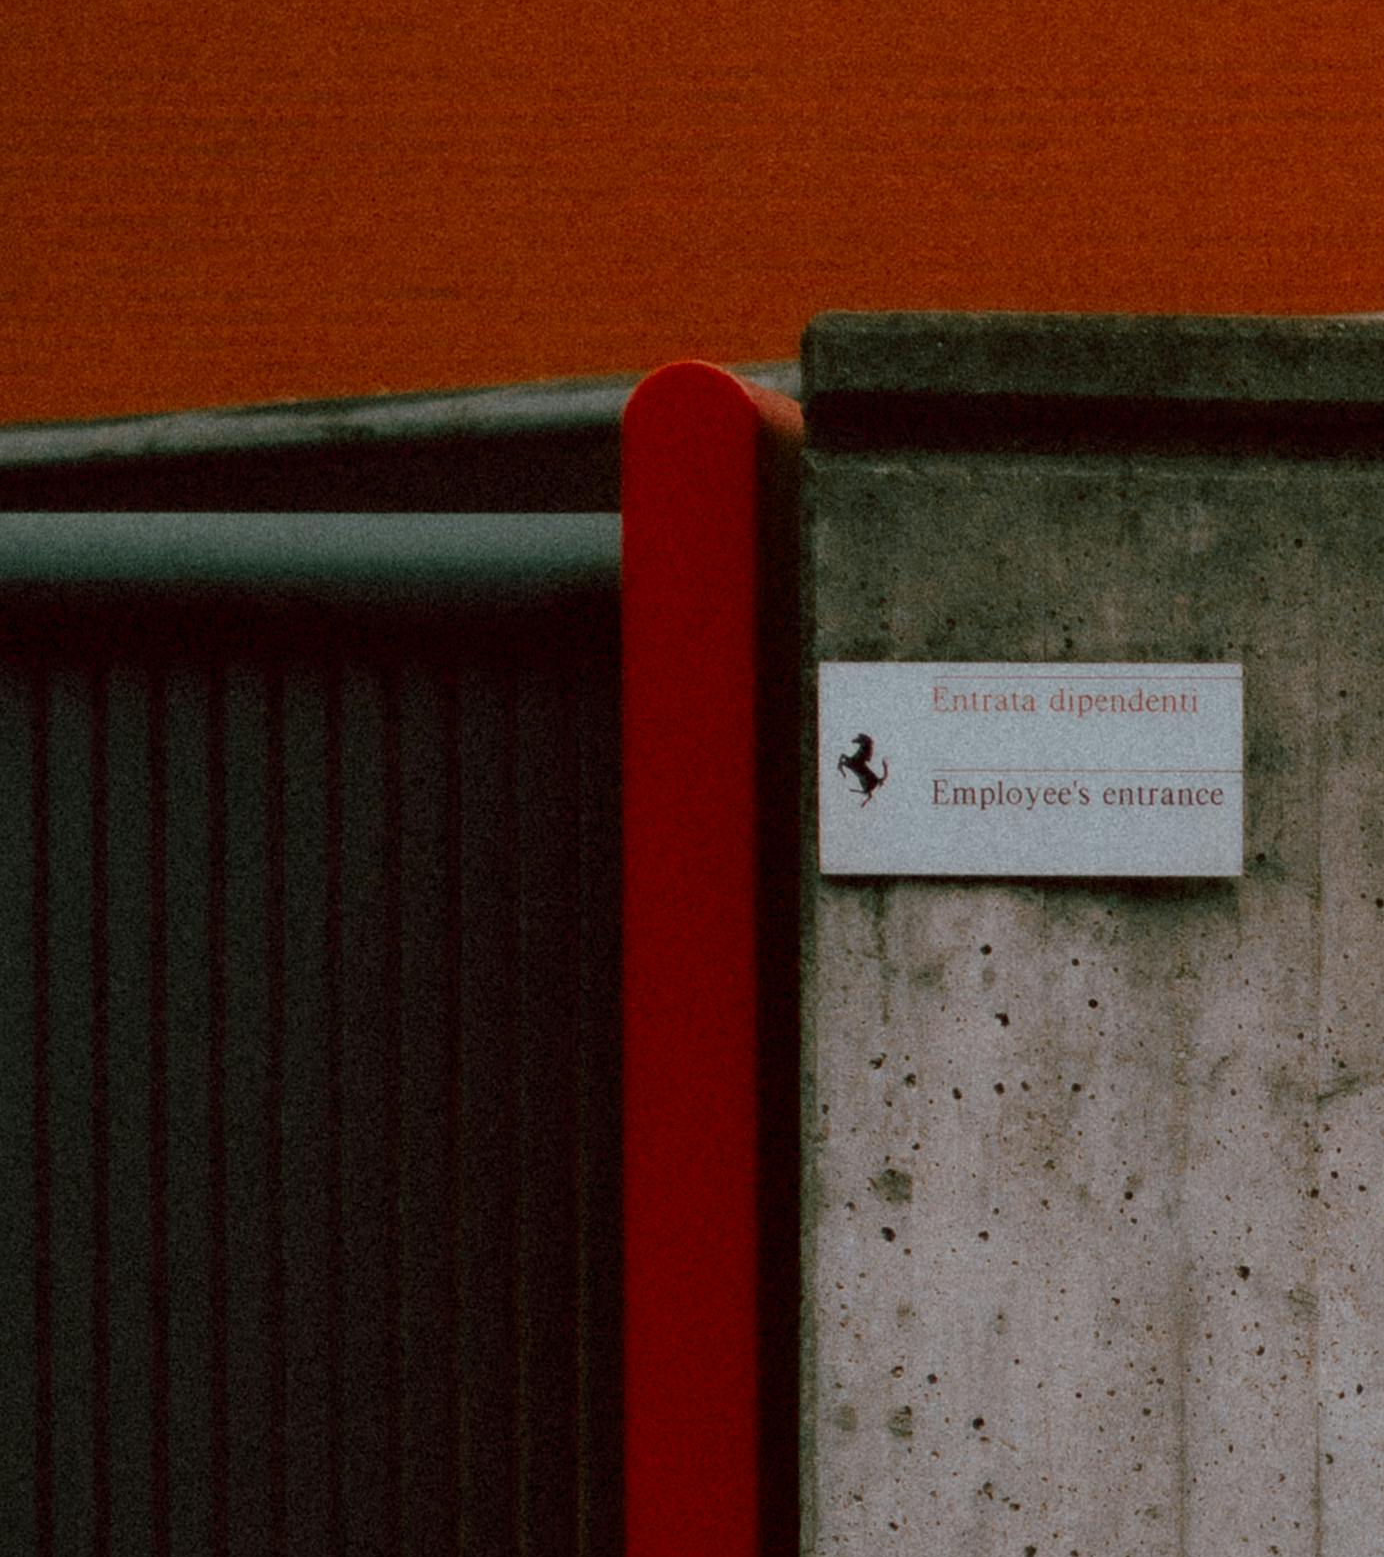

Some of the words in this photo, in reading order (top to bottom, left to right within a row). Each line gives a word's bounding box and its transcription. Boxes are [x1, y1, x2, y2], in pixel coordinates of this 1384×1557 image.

[932, 686, 1037, 713] Entrata
[1048, 687, 1199, 718] dipendenti
[932, 778, 1091, 811] Employee's
[1102, 784, 1225, 807] entrance
